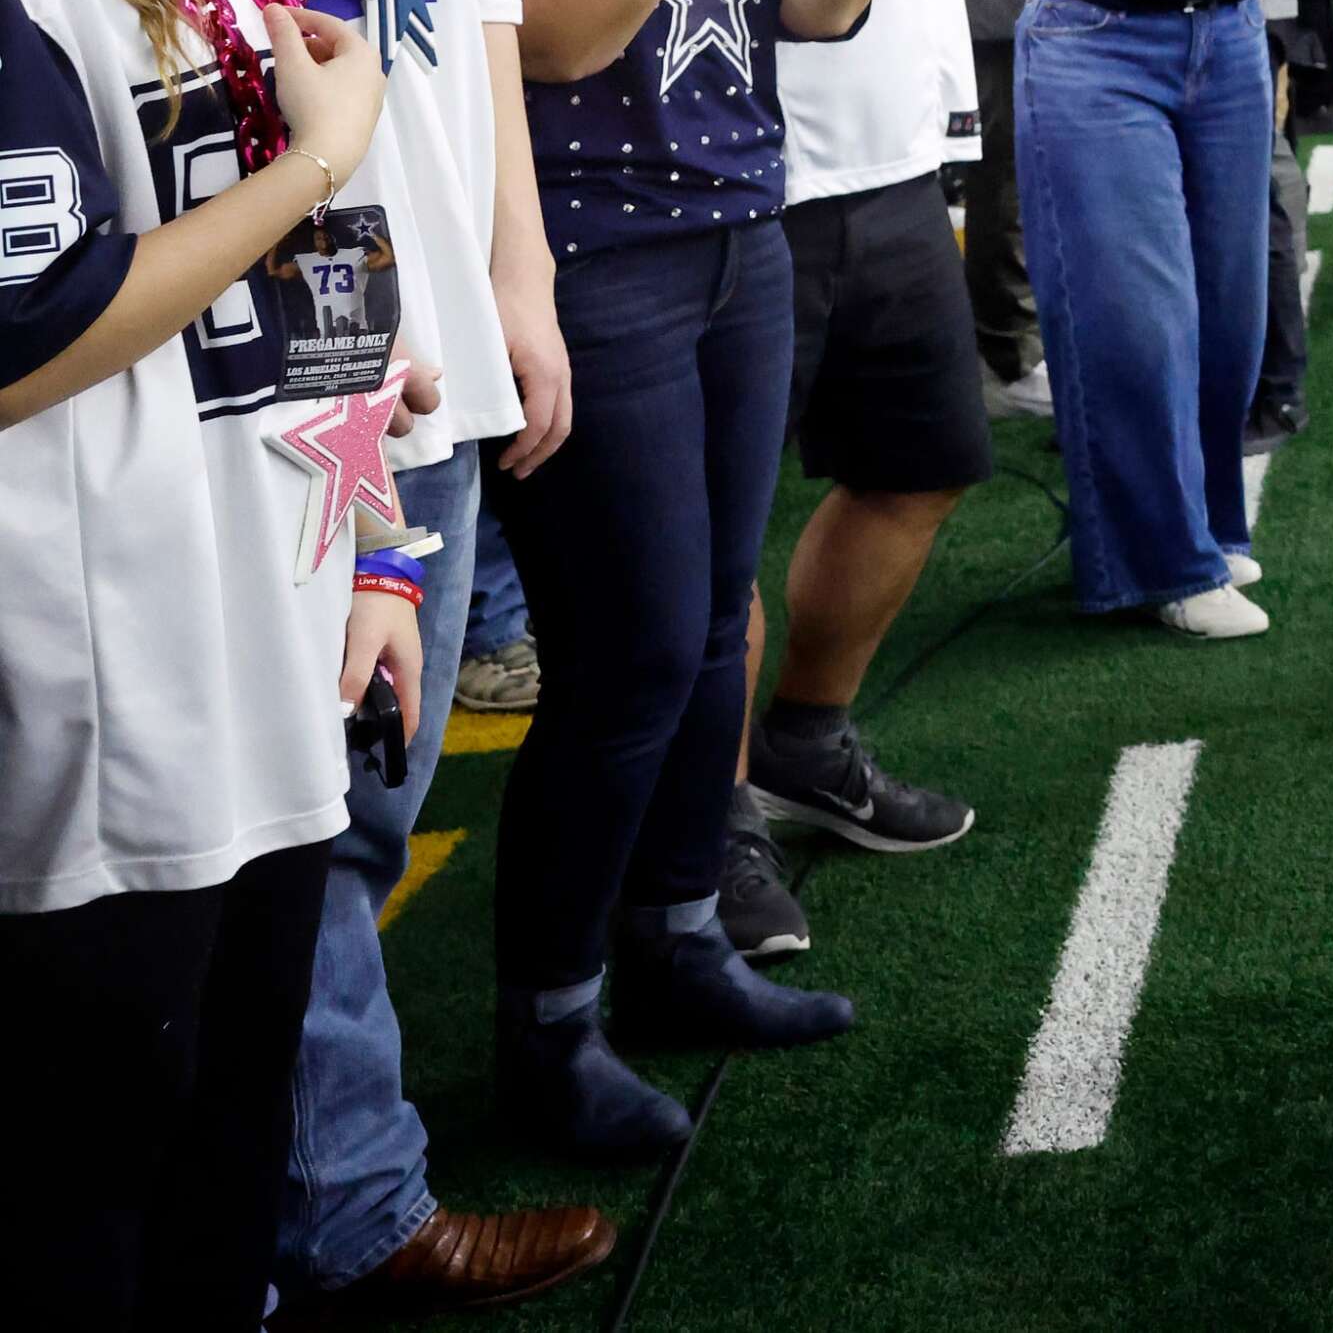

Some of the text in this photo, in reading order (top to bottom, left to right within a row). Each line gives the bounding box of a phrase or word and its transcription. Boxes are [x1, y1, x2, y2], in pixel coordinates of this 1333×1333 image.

[312, 263, 355, 296] 73
[288, 332, 391, 354] PREGAME ONLY
[286, 358, 383, 377] LOS ANGELES CHARGERS
[358, 577, 378, 585] Live
